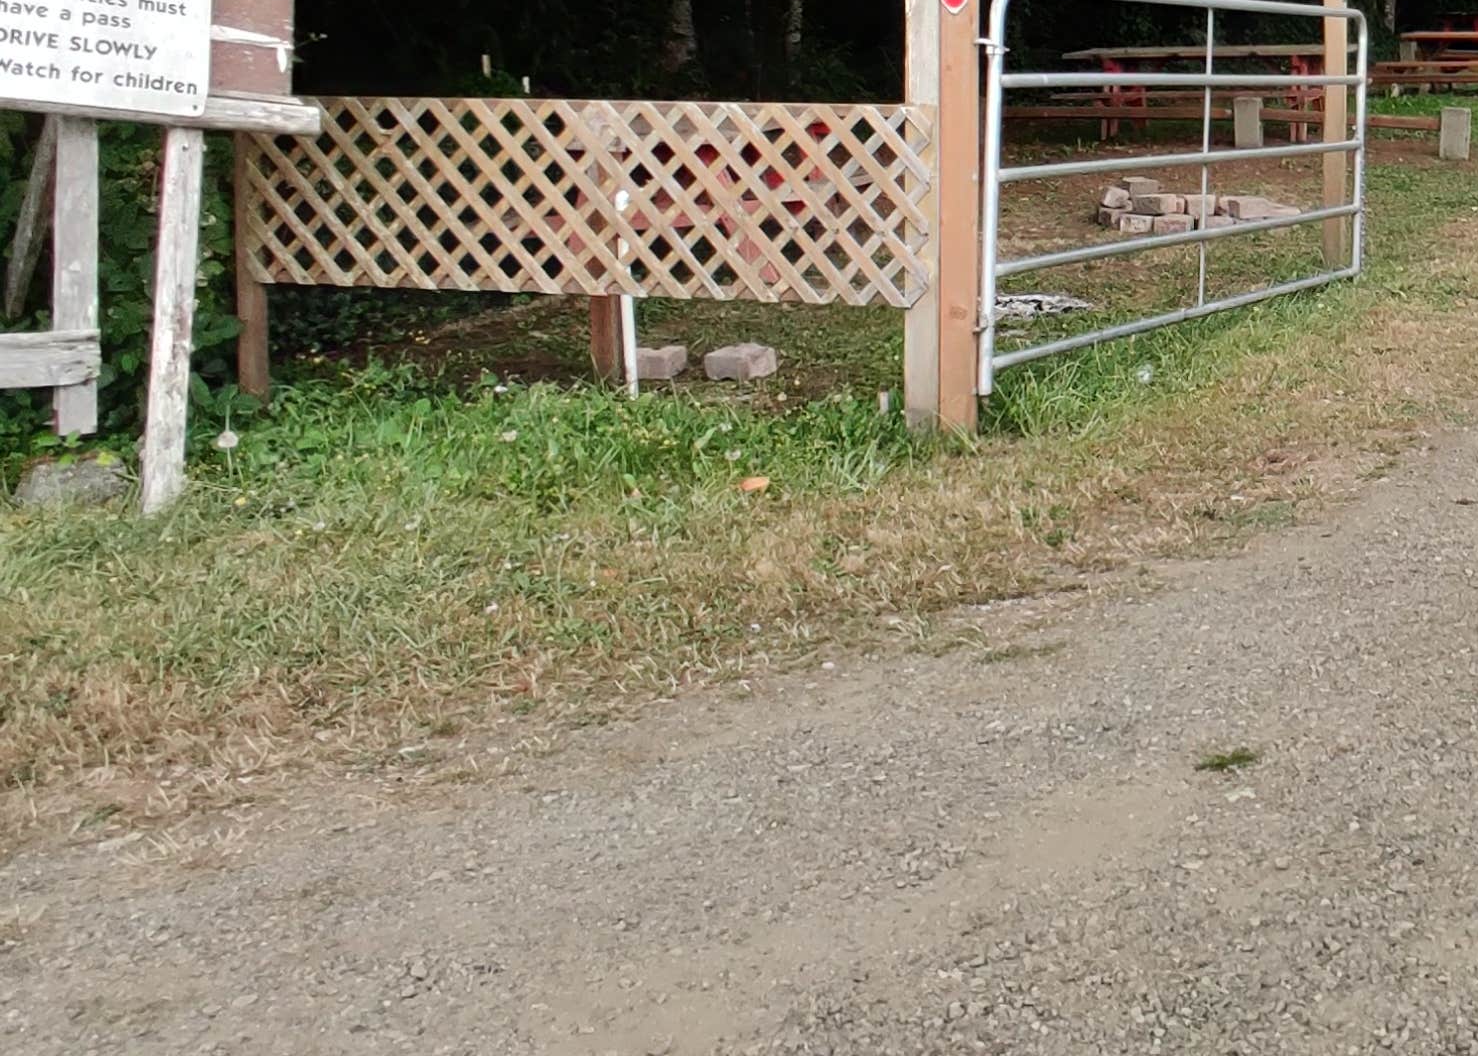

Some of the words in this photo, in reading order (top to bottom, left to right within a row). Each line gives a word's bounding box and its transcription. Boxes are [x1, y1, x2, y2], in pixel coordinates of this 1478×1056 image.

[60, 8, 72, 21] a
[82, 12, 132, 29] pass
[138, 0, 187, 16] must
[69, 35, 158, 61] SLOWLY
[71, 65, 104, 84] for
[113, 72, 198, 95] children
